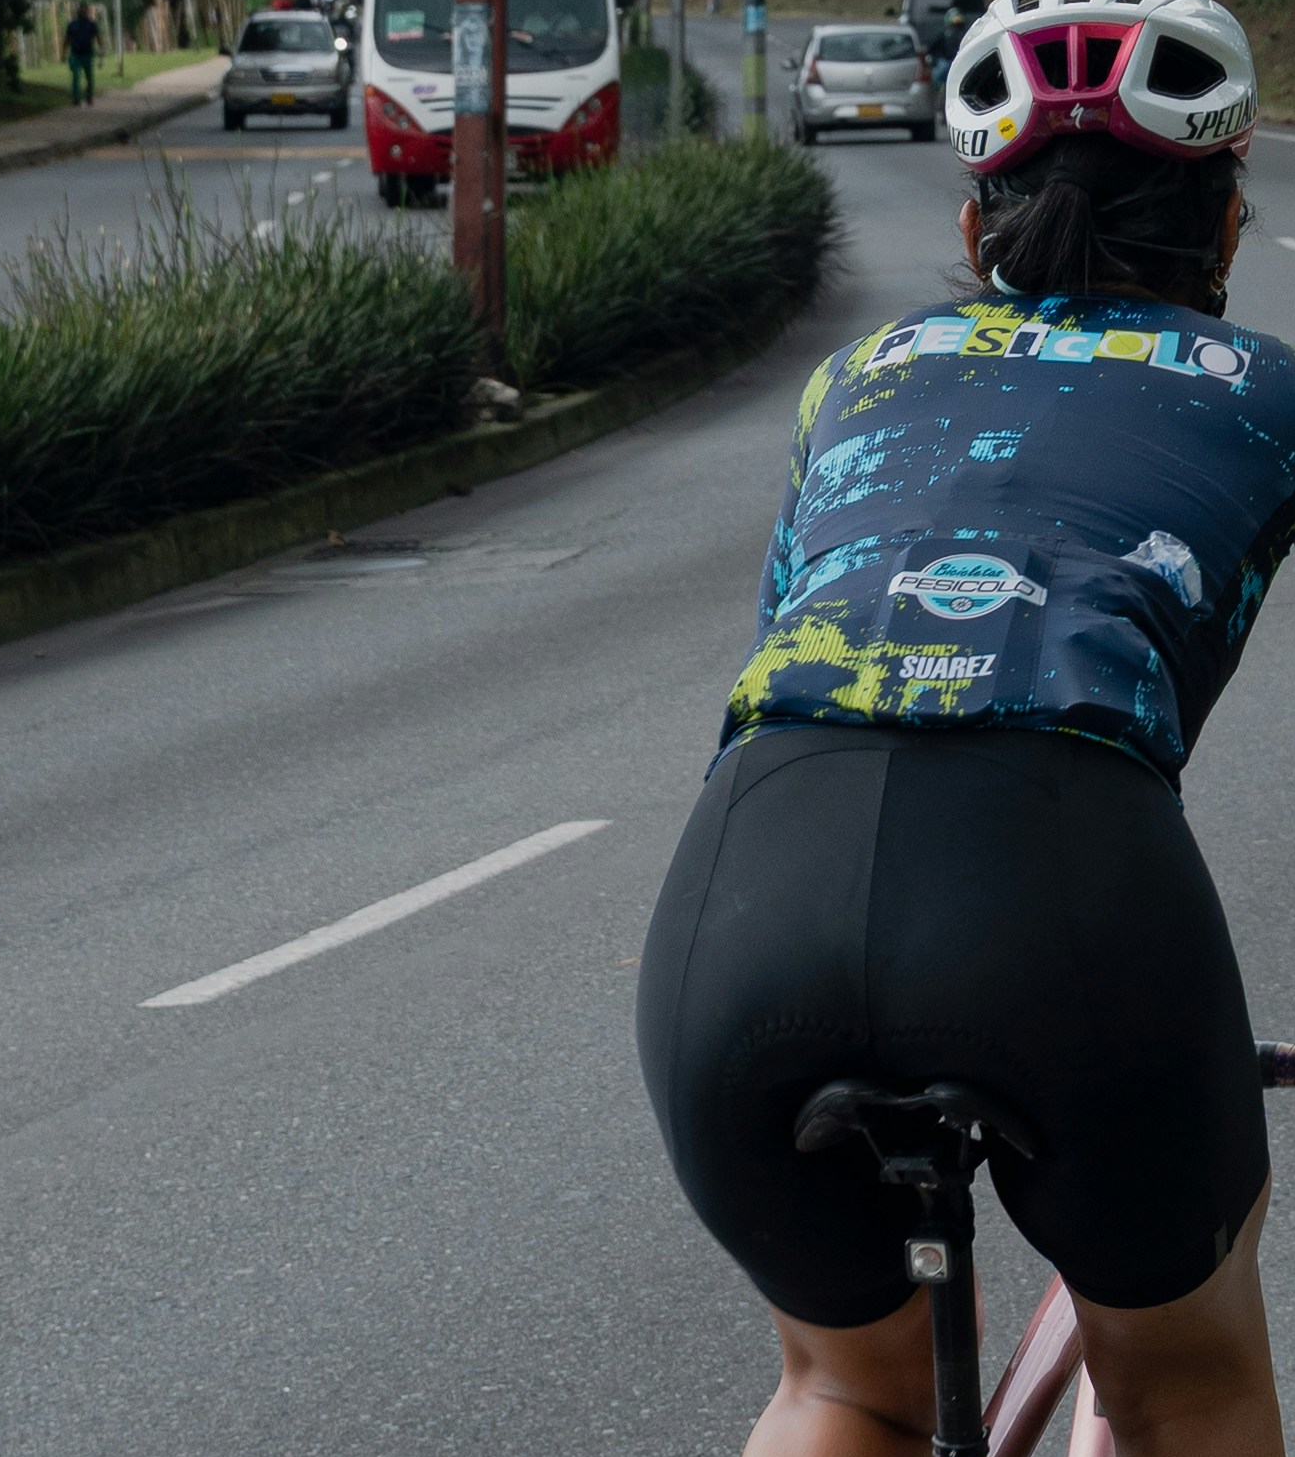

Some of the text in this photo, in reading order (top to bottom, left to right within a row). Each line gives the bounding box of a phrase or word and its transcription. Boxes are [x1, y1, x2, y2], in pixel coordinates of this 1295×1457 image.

[868, 320, 1249, 380] PESICOLO
[934, 563, 1005, 577] Bicicletas
[899, 576, 1035, 597] PESICOLO
[899, 653, 997, 680] SUAREZ
